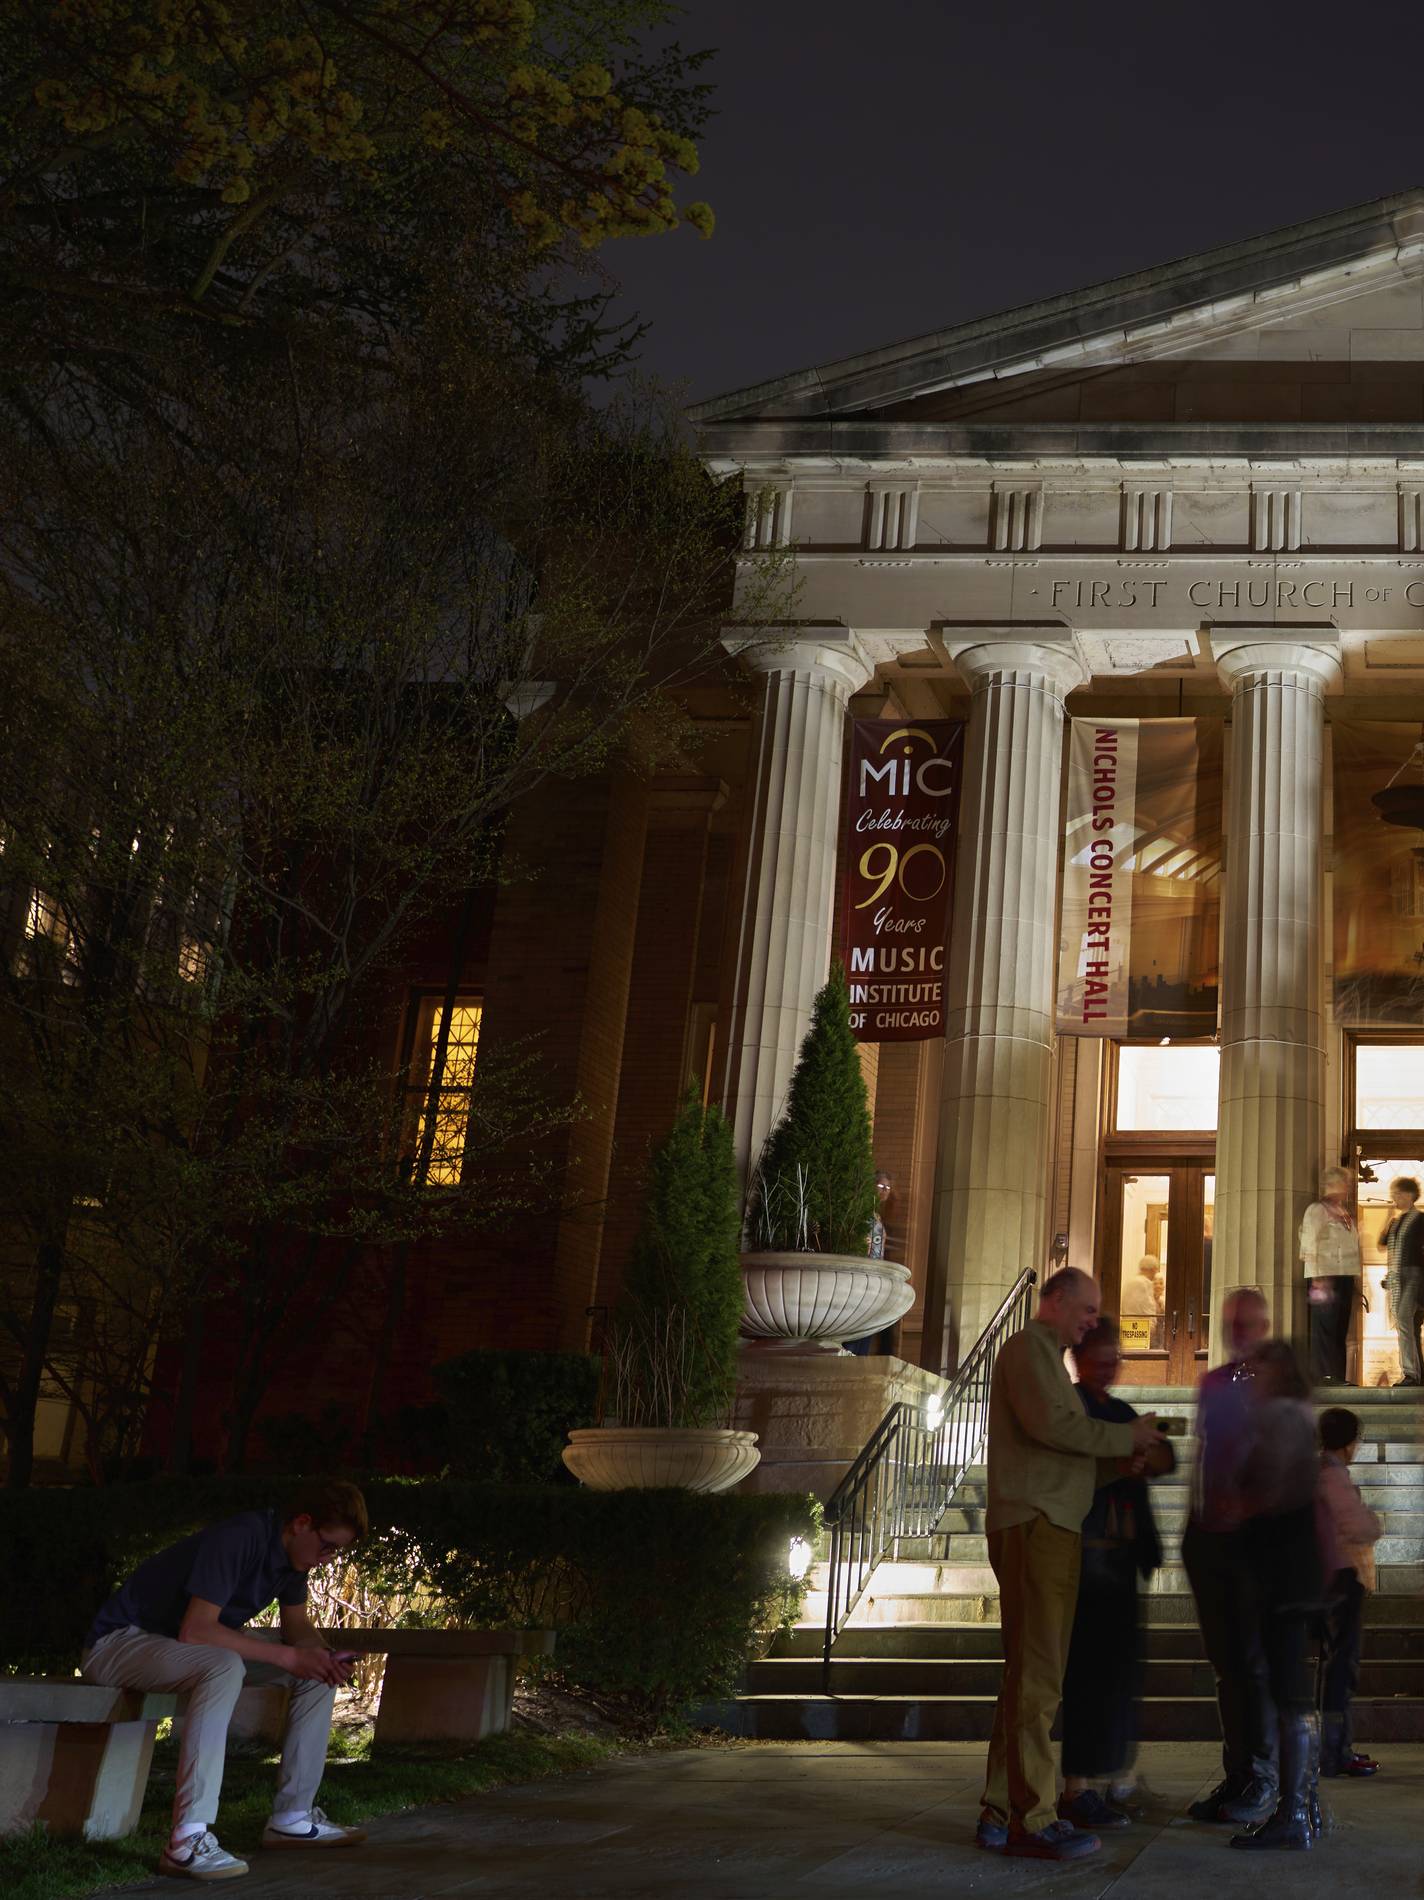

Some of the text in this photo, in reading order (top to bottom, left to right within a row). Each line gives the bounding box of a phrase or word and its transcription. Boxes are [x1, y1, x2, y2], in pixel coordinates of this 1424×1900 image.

[1051, 580, 1168, 608] FIRST
[1187, 580, 1354, 608] CHURCH
[1364, 586, 1393, 602] OF
[856, 808, 951, 839] Celebrating
[855, 842, 946, 910] 90
[1083, 728, 1118, 1024] NICHOLS CONCERT HALL
[873, 906, 927, 935] Years
[850, 946, 944, 972] MUSIC
[849, 982, 942, 1004] INSTITUTE
[848, 1010, 940, 1029] OF CHICAGO
